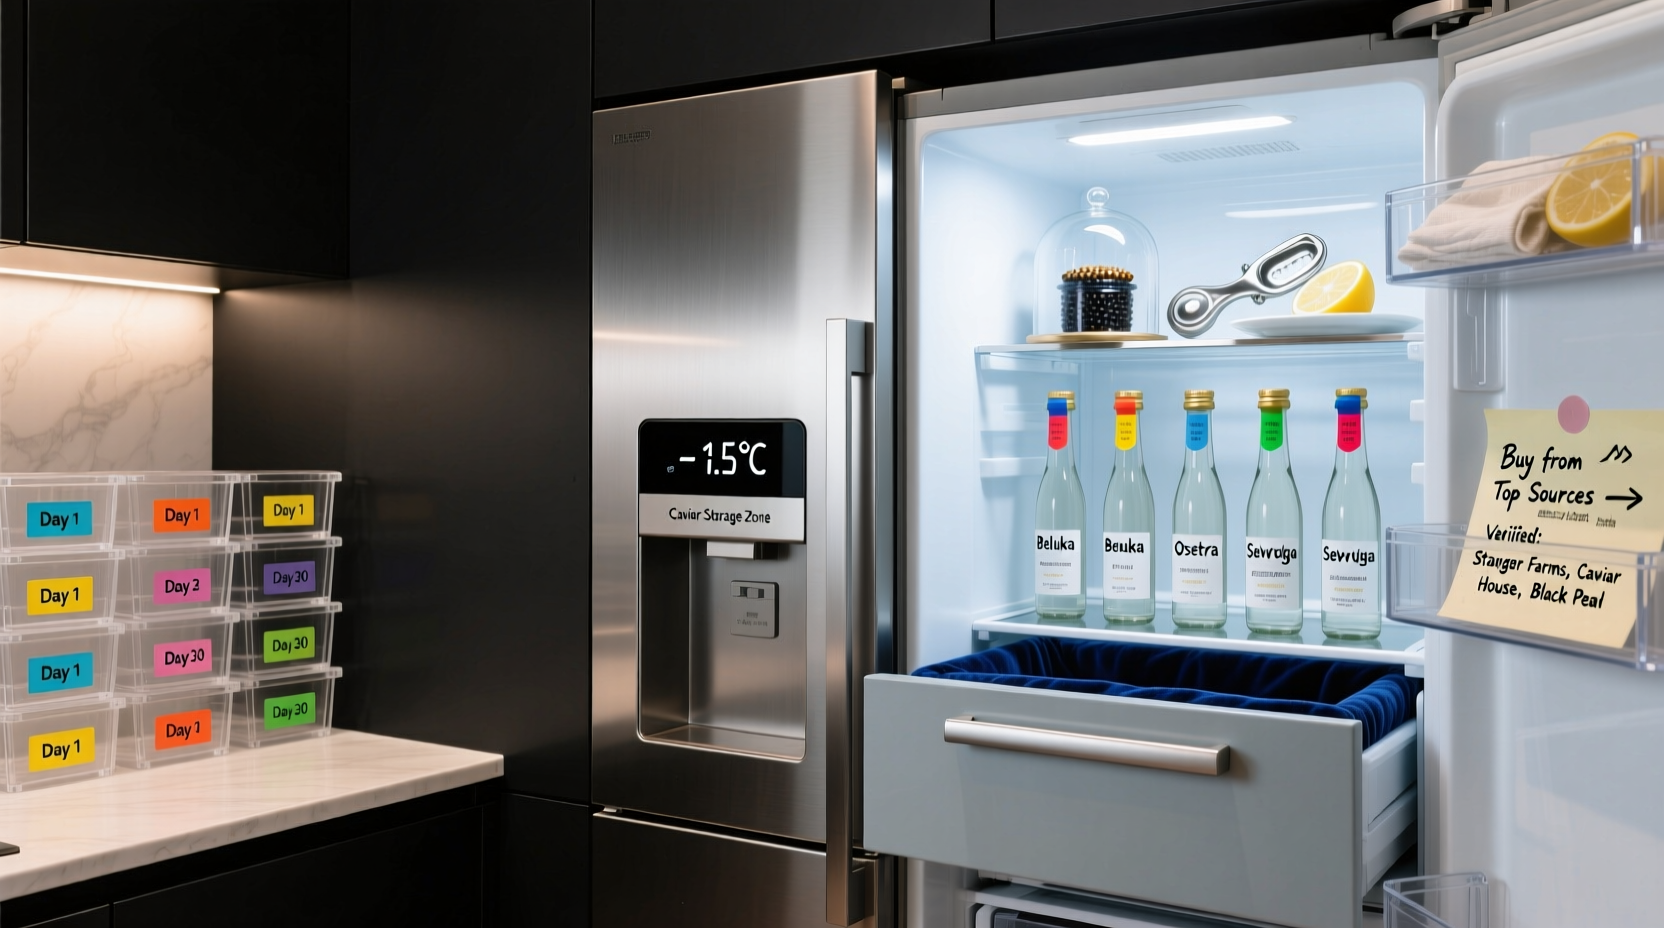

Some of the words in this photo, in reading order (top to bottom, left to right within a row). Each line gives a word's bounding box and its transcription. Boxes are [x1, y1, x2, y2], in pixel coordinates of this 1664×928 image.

[1500, 443, 1534, 480] Buy
[1542, 446, 1582, 473] from
[1494, 480, 1520, 512] Top
[1528, 482, 1595, 505] Sources
[40, 512, 70, 531] Day
[72, 513, 79, 526] 1
[165, 507, 191, 527] Day
[194, 508, 199, 521] 1
[274, 503, 296, 521] Day
[299, 503, 304, 515] 1
[669, 507, 702, 521] Caviar
[744, 510, 771, 524] Zone
[1037, 535, 1075, 551] Beluka
[1174, 540, 1219, 557] Osetra
[1527, 556, 1571, 580] Farms,
[1577, 563, 1622, 585] Caviar
[40, 588, 69, 607] Day
[73, 587, 79, 601] 1
[165, 579, 190, 596] Day
[1477, 576, 1522, 600] House,
[1529, 582, 1568, 604] Black
[165, 651, 190, 668] Day
[190, 648, 205, 662] 30
[41, 666, 70, 683] Day
[74, 664, 80, 677] 1
[42, 743, 71, 760] Day
[74, 739, 81, 753] 1
